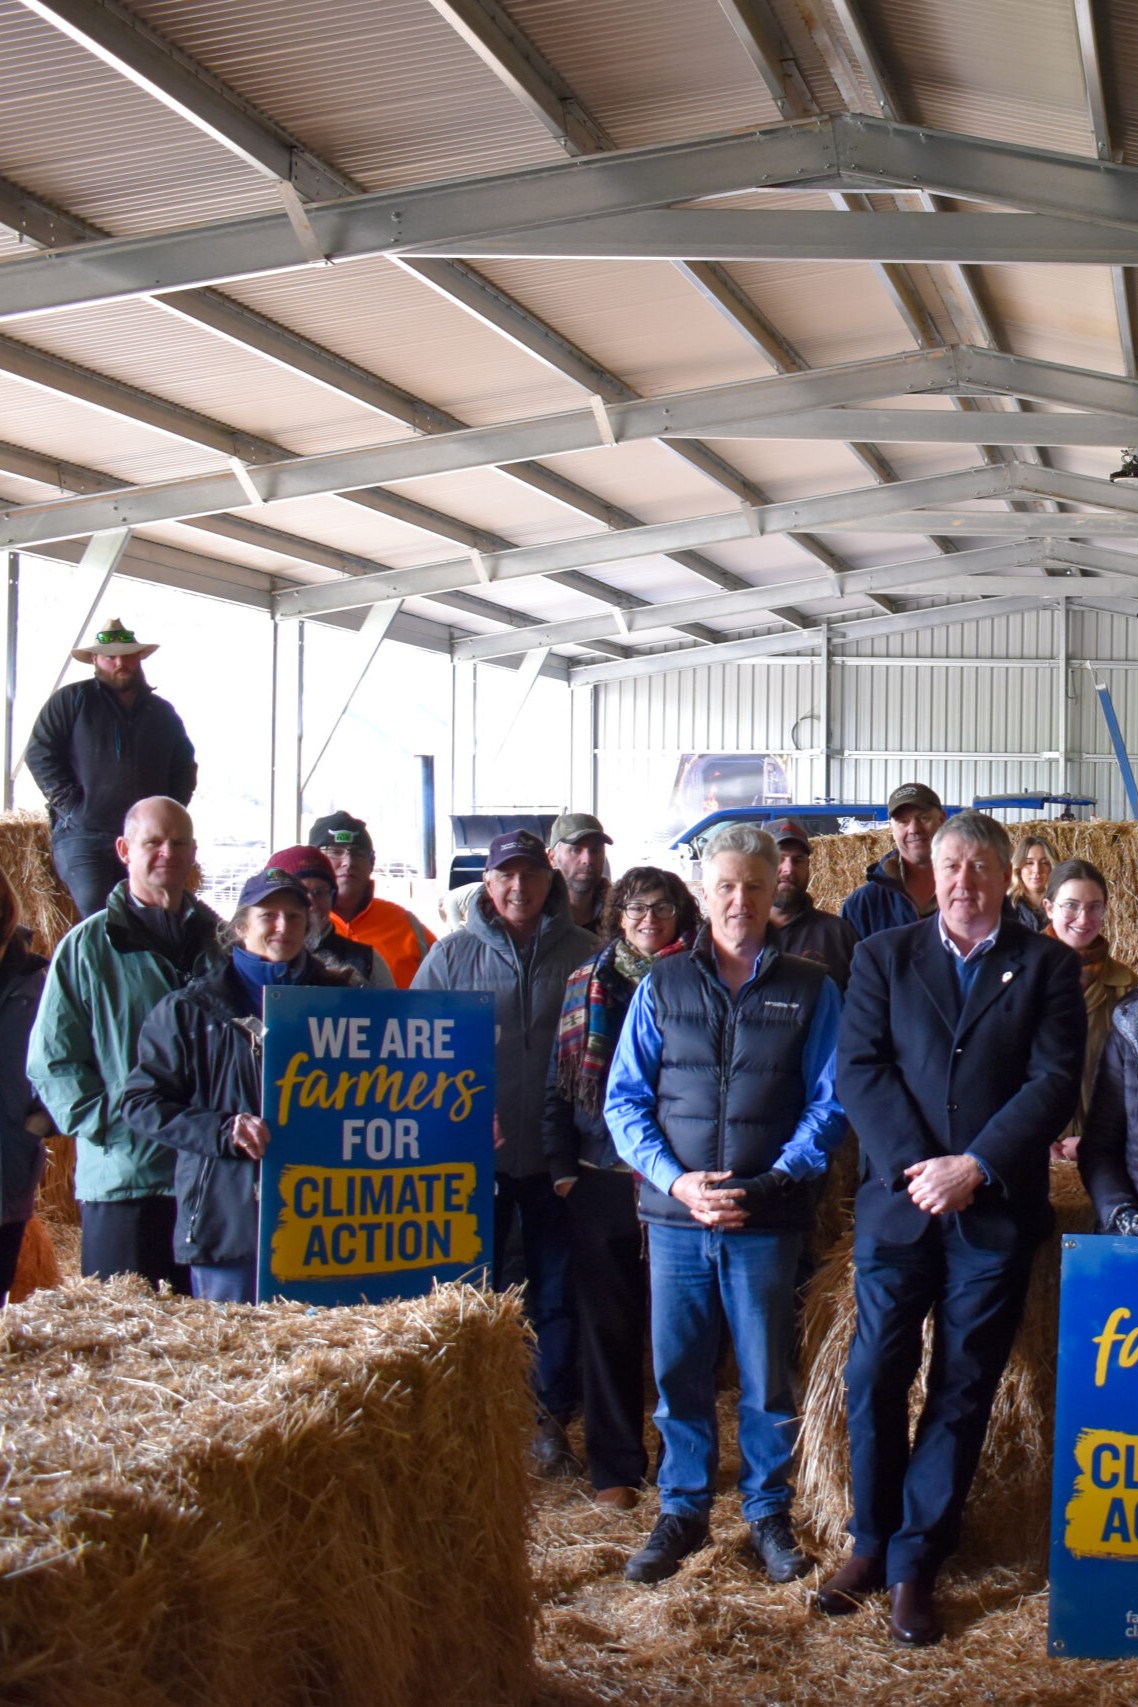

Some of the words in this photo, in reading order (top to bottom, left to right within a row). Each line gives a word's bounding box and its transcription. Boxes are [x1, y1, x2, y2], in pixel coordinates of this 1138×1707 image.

[308, 1016, 371, 1059] WE
[379, 1018, 455, 1059] ARE
[274, 1052, 487, 1126] farmers
[342, 1118, 420, 1160] FOR
[293, 1172, 465, 1219] CLIMATE
[302, 1219, 452, 1266] ACTION
